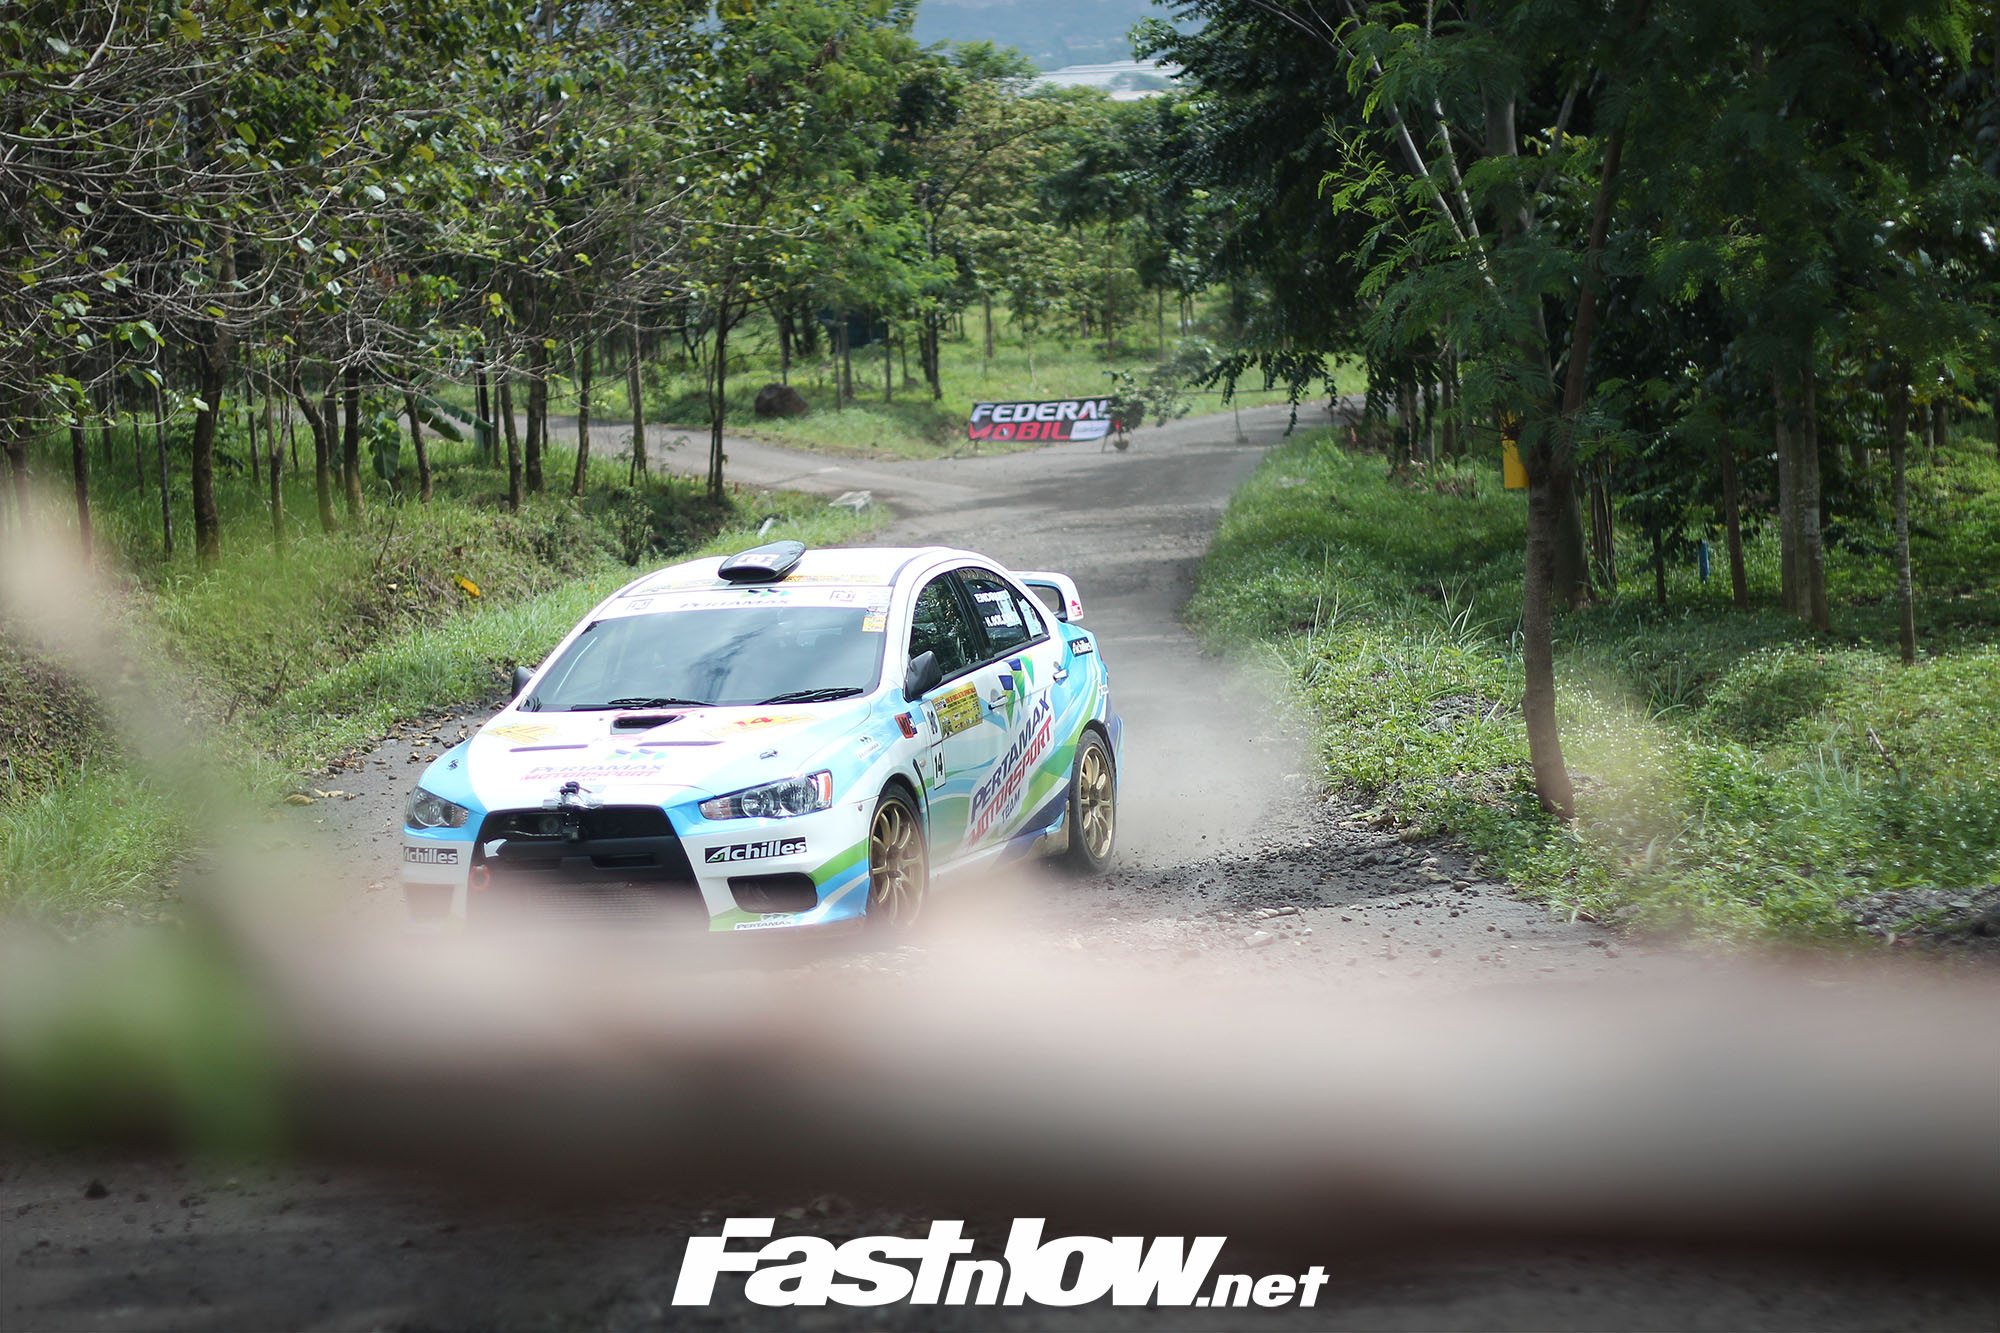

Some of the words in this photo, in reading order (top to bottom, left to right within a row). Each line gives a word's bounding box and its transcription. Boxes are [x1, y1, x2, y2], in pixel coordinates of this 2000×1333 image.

[970, 400, 1111, 423] FEDERAL
[969, 421, 1070, 440] MOBIL
[934, 752, 944, 779] 14
[970, 689, 1051, 825] PERTAMAX
[968, 714, 1052, 848] MOTORSPORT
[1001, 788, 1021, 824] TEAM
[706, 840, 806, 863] Achilles
